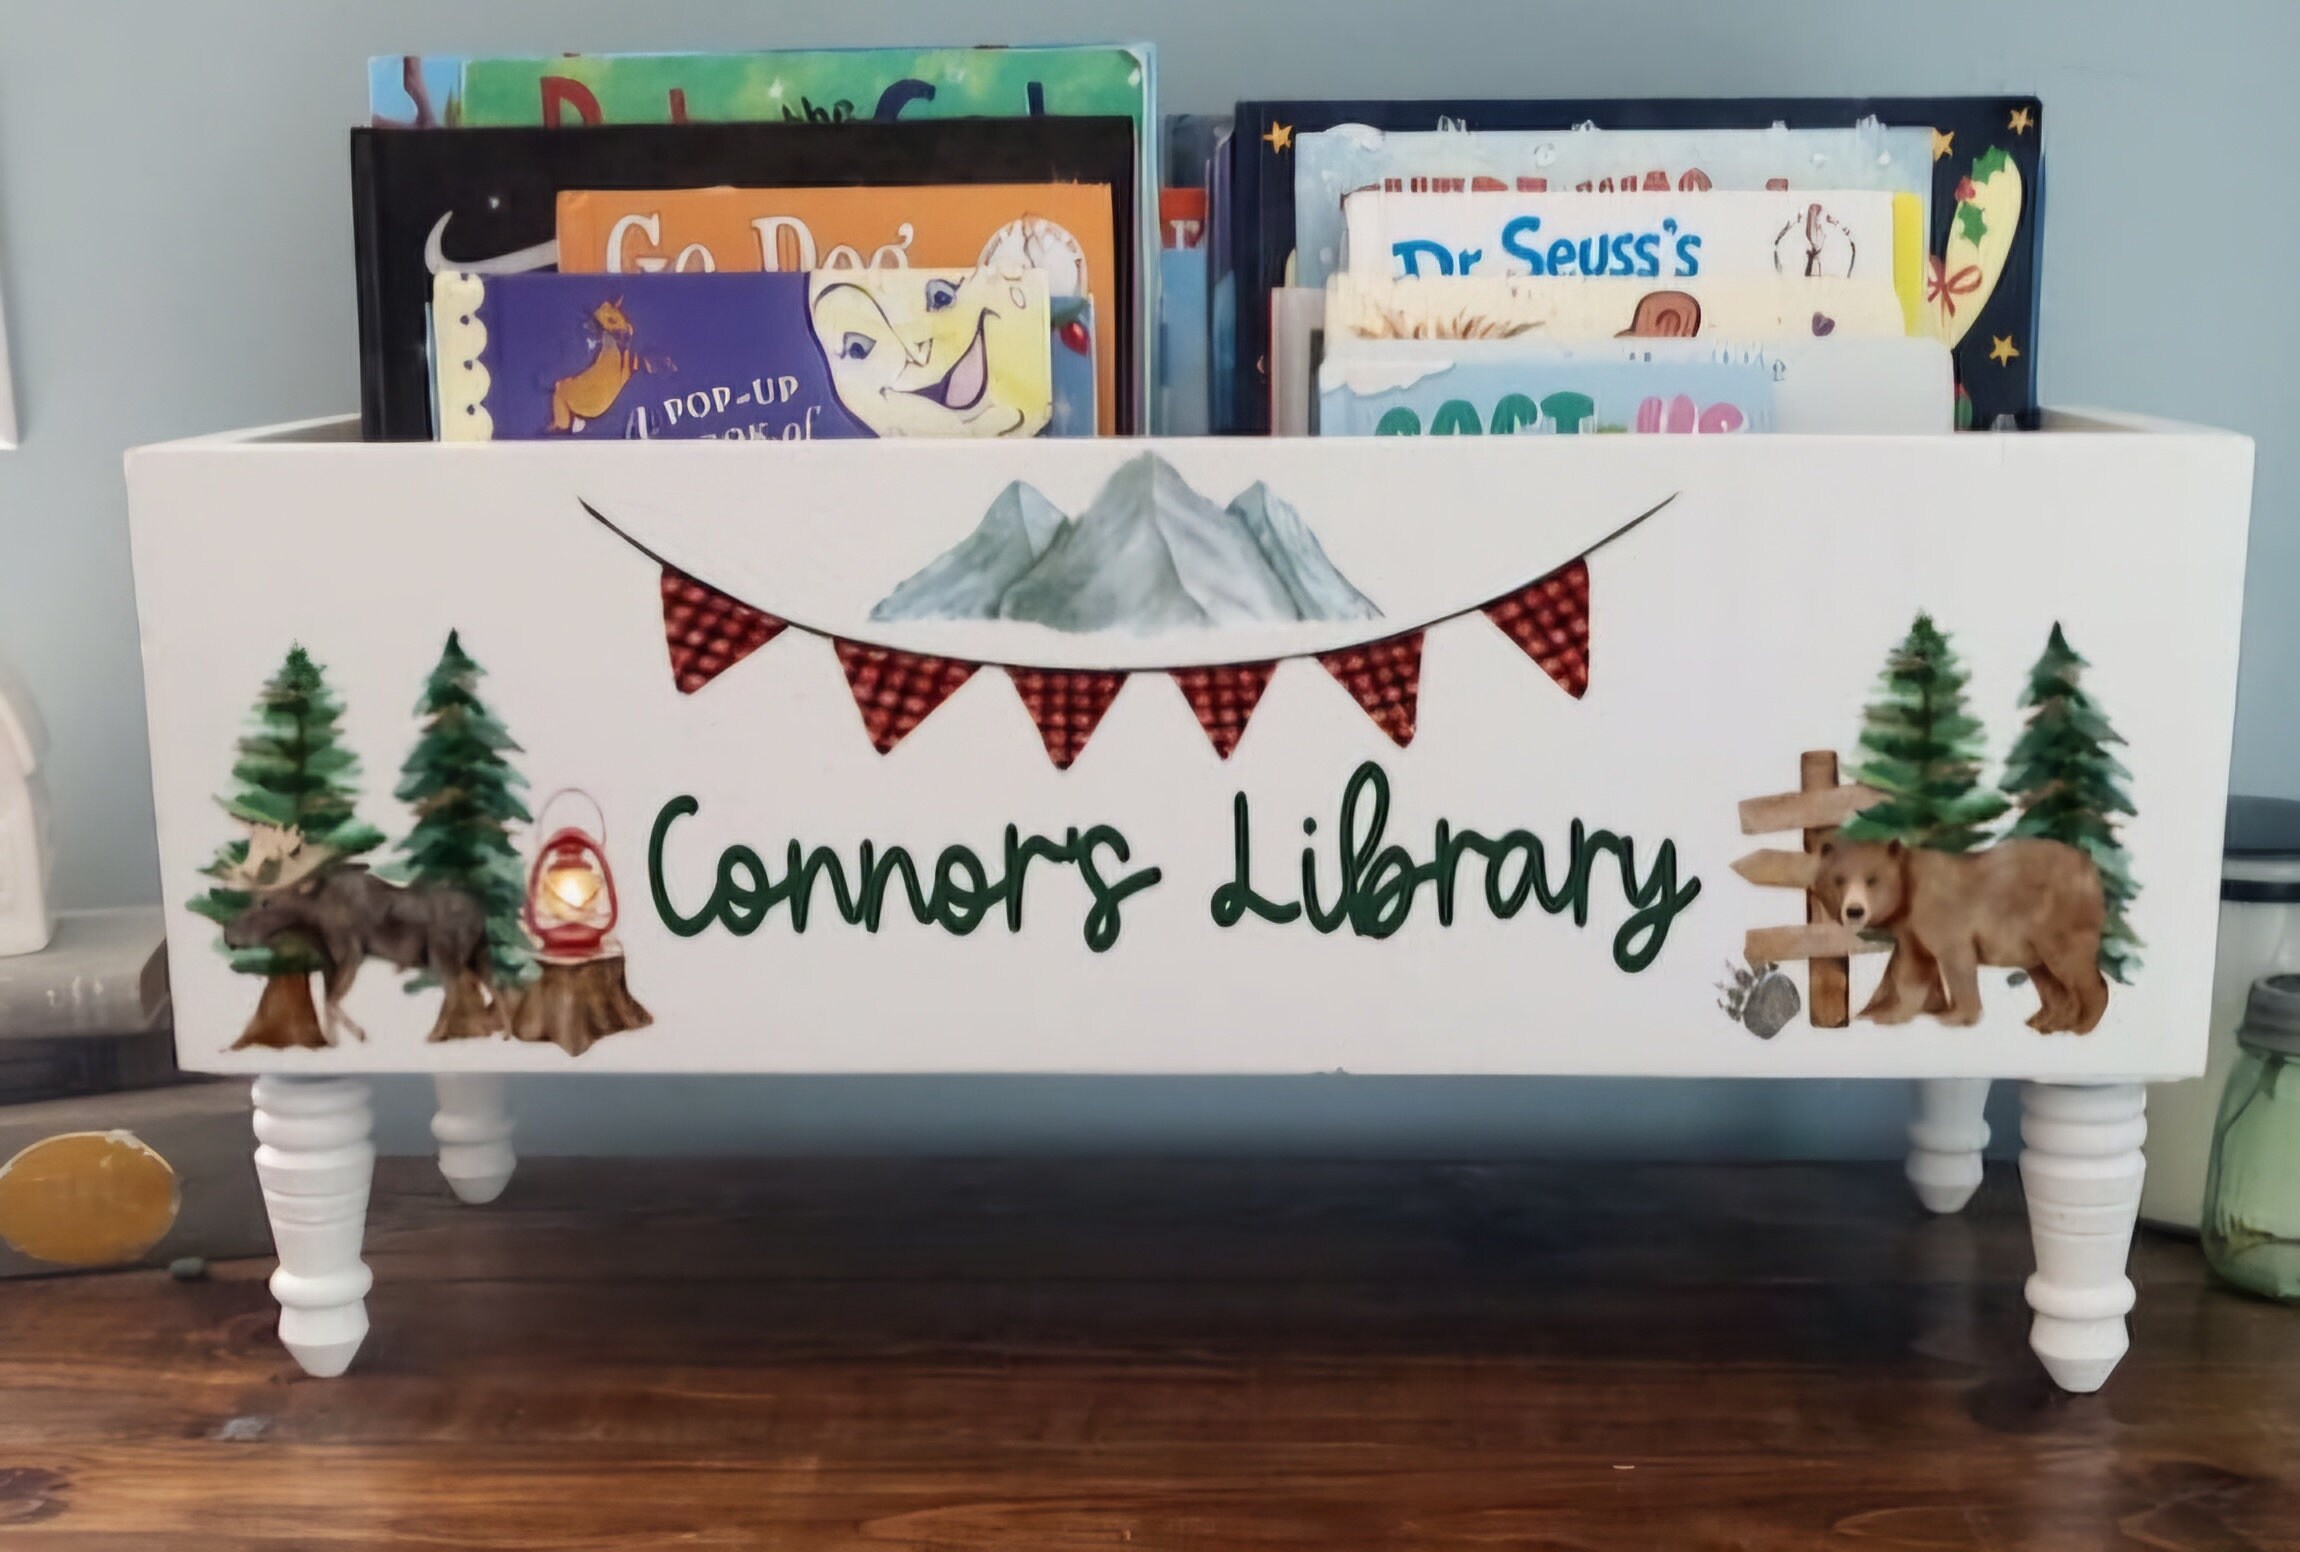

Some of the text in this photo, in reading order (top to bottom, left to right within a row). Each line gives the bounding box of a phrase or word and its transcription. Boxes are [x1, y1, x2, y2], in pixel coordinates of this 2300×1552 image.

[1501, 215, 1702, 277] Seuss's
[663, 375, 799, 425] POP-UP
[1210, 756, 1701, 974] Library
